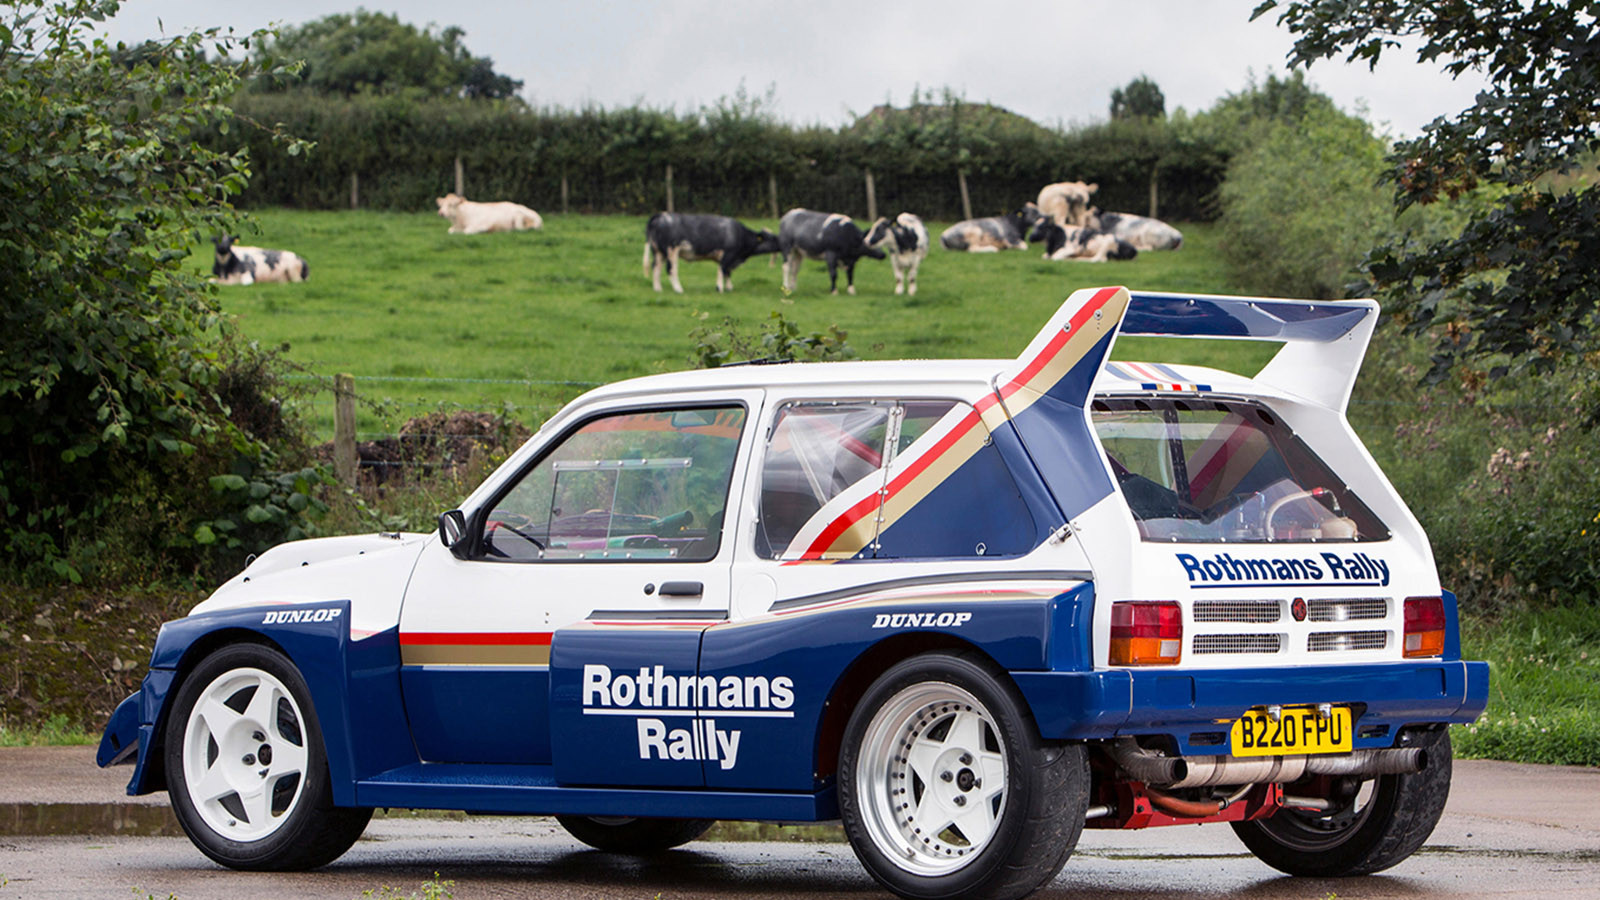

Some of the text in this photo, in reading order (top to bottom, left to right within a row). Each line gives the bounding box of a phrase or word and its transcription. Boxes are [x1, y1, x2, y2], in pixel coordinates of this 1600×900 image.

[1175, 552, 1390, 587] Rothmans Rally
[262, 608, 342, 625] DUNLOP
[872, 612, 972, 629] DUNLOP
[582, 664, 795, 709] Rothmans
[637, 718, 742, 770] Rally
[1241, 713, 1342, 748] B220 FPU
